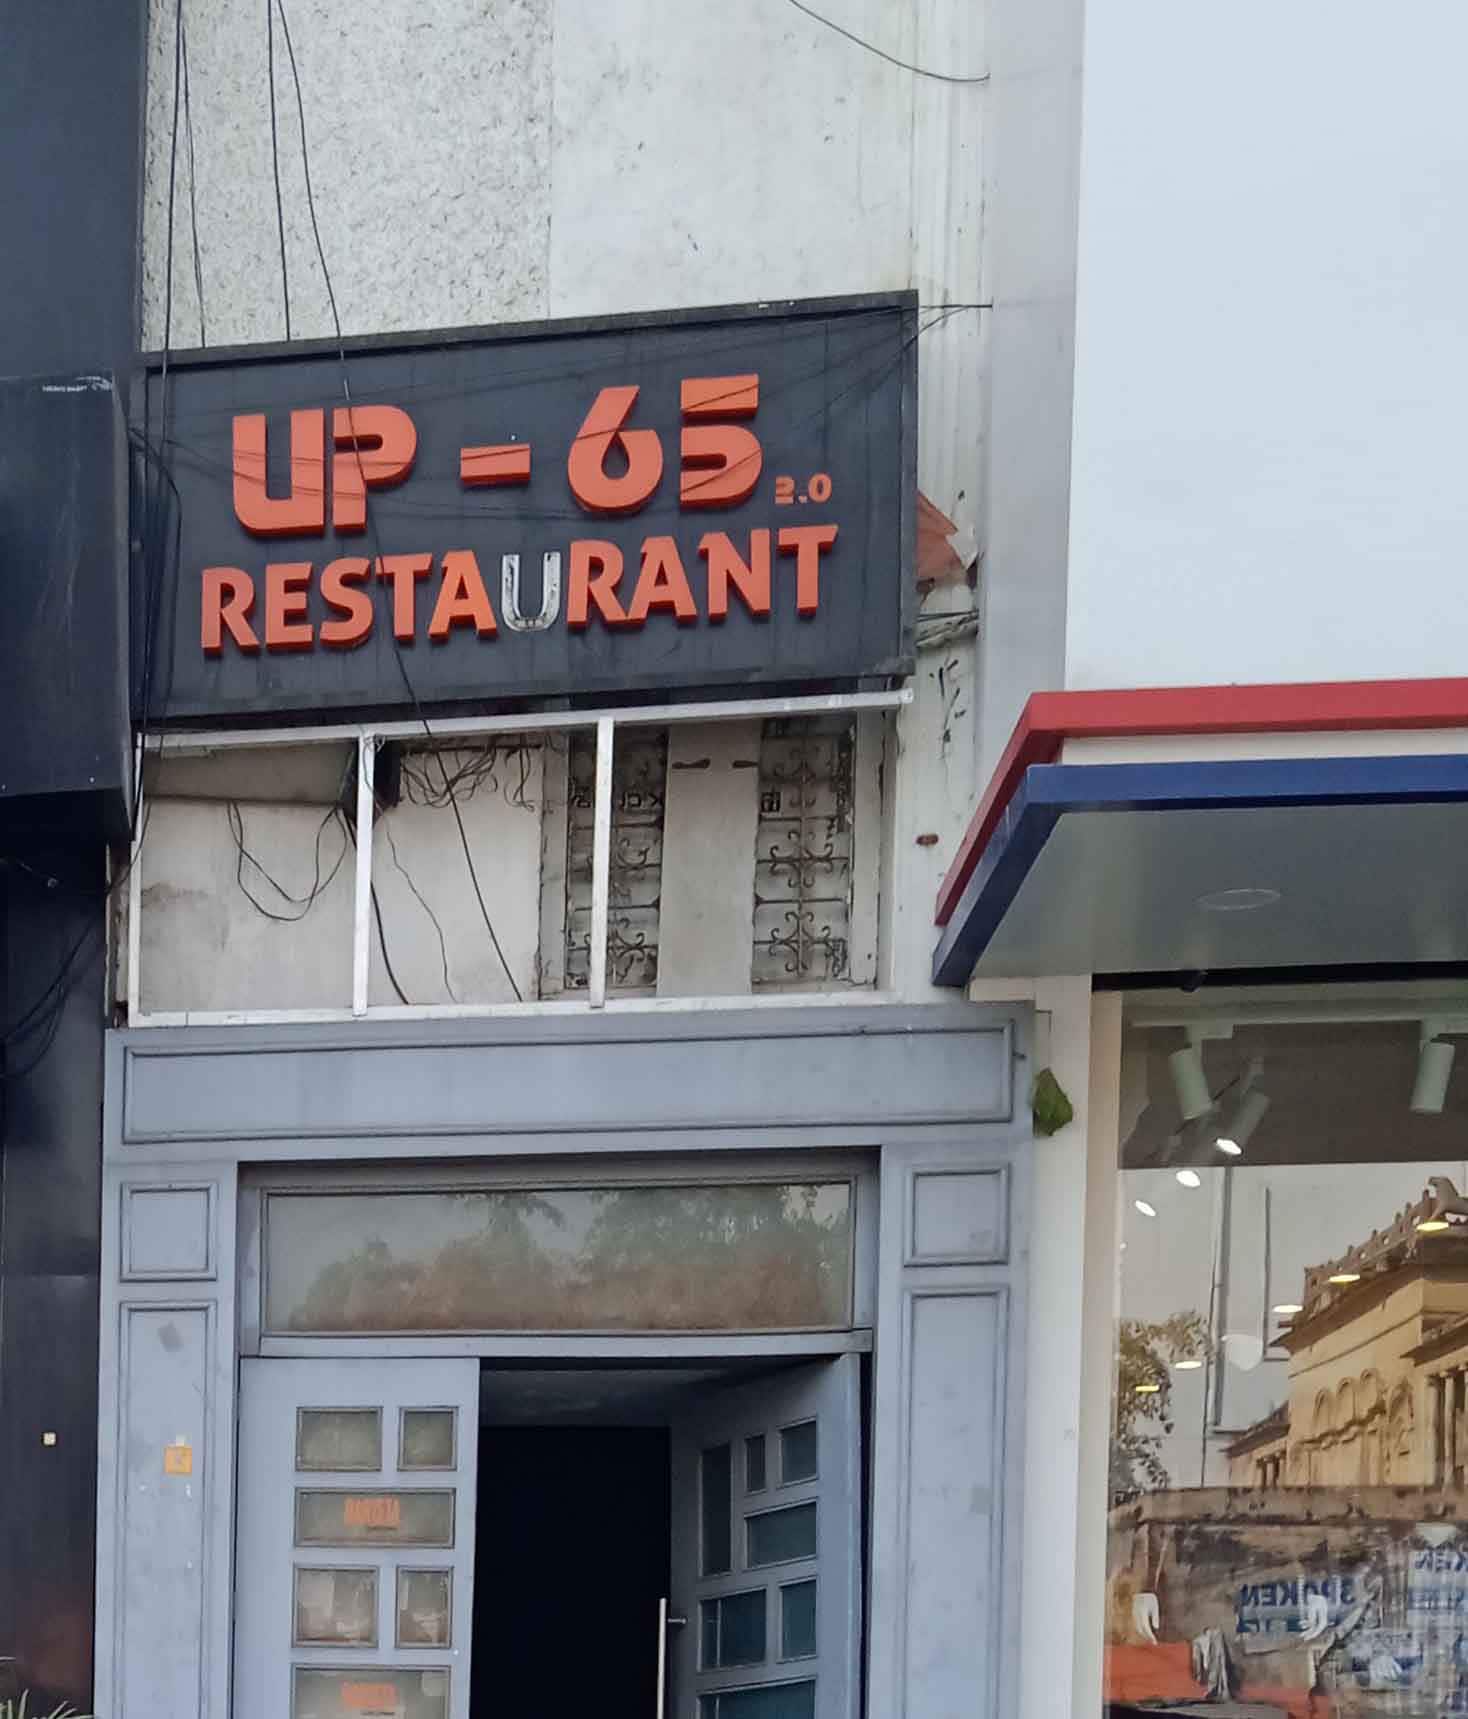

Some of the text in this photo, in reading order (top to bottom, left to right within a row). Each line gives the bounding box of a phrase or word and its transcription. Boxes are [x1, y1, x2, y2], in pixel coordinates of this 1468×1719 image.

[231, 404, 418, 535] UP
[566, 373, 764, 512] 65
[774, 472, 833, 507] 2.0
[200, 524, 838, 653] RESTAURANT
